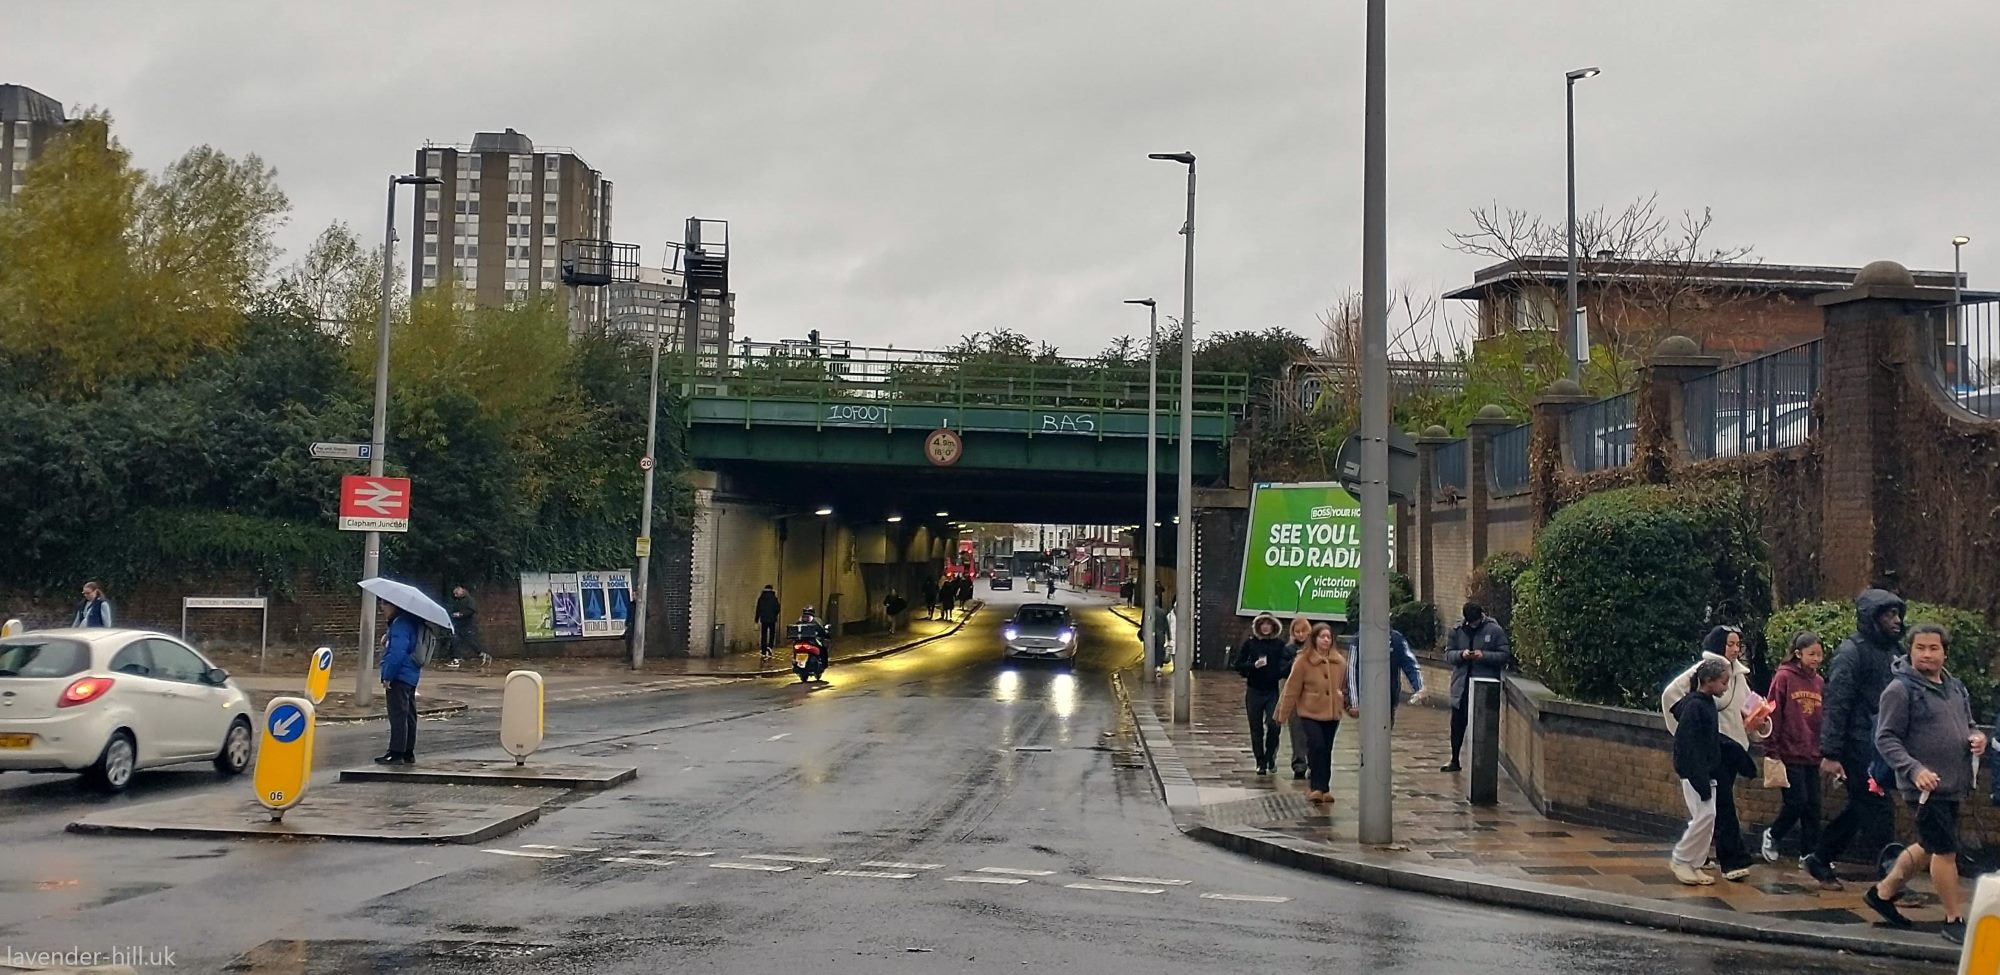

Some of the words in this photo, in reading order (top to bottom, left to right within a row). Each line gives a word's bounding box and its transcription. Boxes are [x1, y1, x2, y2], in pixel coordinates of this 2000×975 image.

[360, 447, 368, 456] P
[1312, 508, 1330, 517] BOSS
[1331, 508, 1351, 517] YOUR
[346, 519, 376, 528] Clapham
[378, 520, 407, 528] Junction
[1269, 524, 1302, 544] SEE
[1306, 524, 1345, 544] YOU
[1265, 547, 1304, 567] OLD
[1313, 575, 1356, 588] victorian
[270, 791, 283, 800] 06
